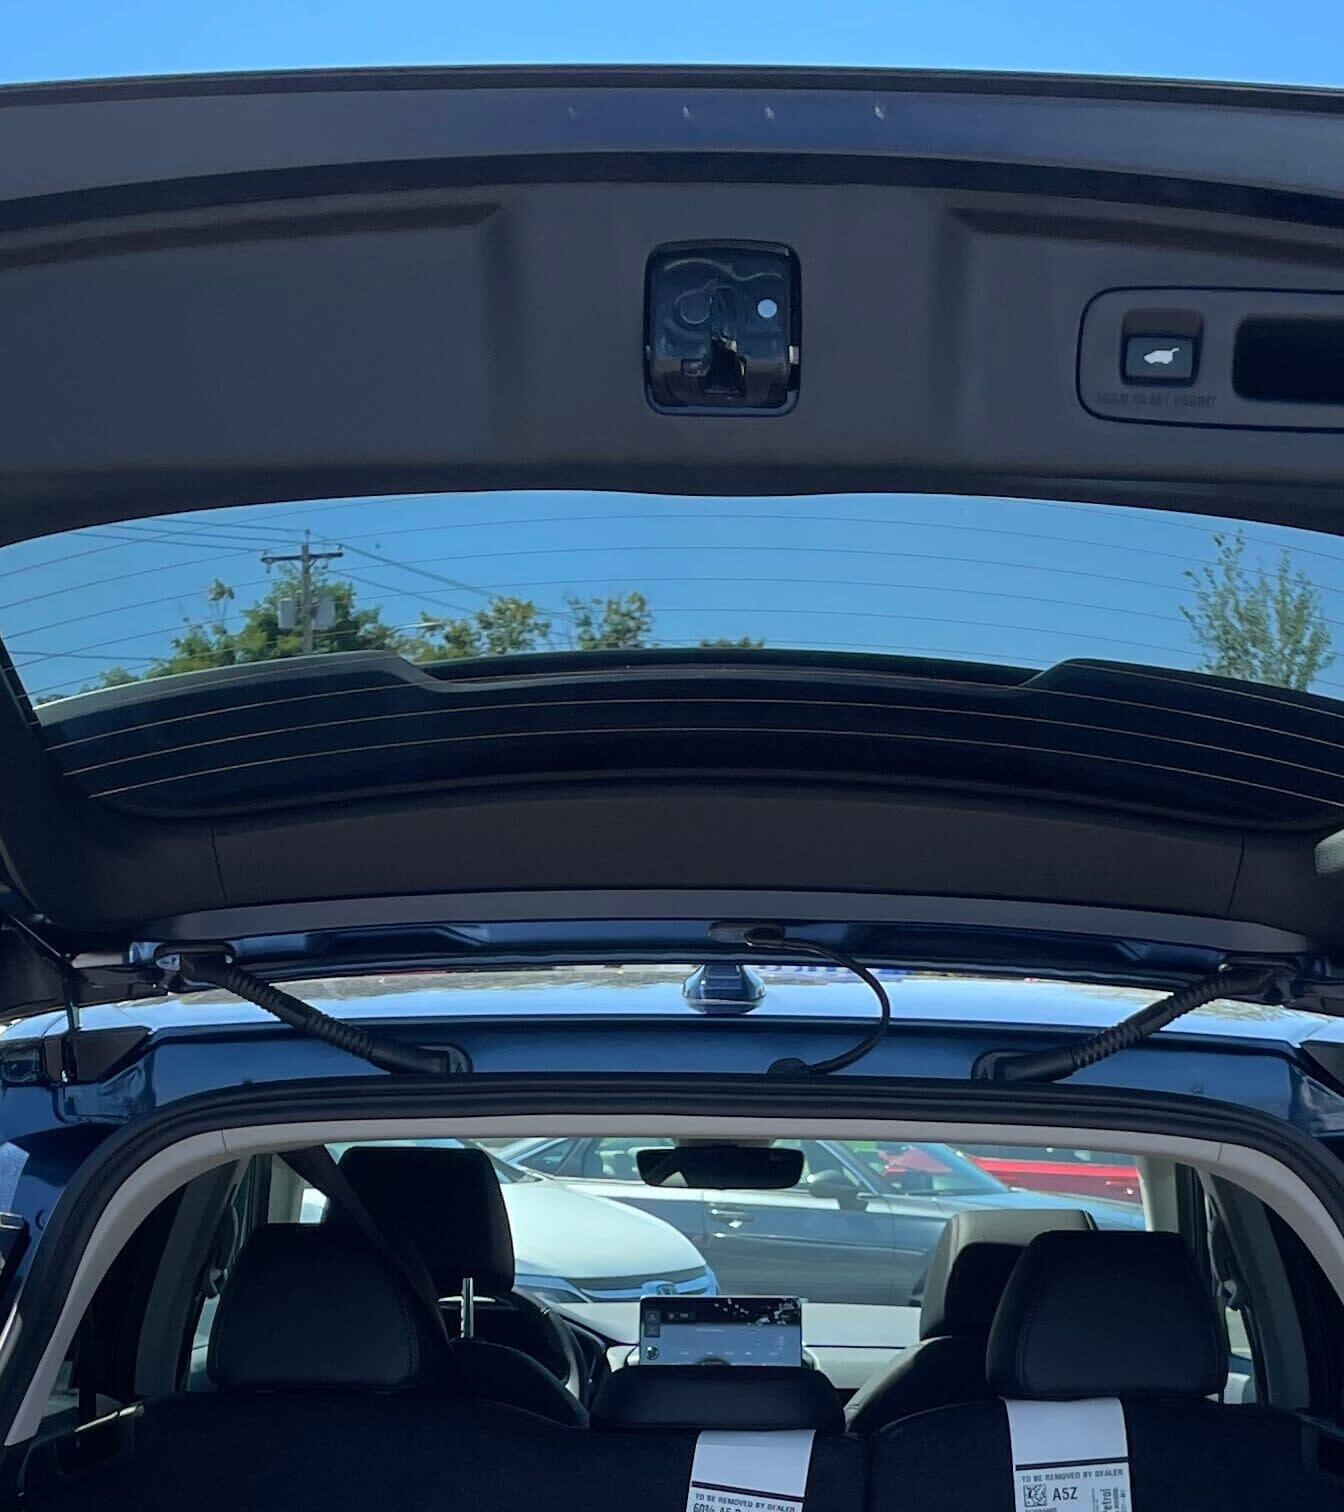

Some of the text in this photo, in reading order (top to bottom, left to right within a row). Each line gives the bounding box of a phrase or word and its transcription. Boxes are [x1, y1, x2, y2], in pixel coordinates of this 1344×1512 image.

[1045, 1472, 1080, 1480] REMOVED
[1095, 1468, 1123, 1477] DEALER
[1053, 1486, 1078, 1501] A5Z
[718, 1496, 753, 1507] REMOVED
[767, 1503, 795, 1512] DEALER
